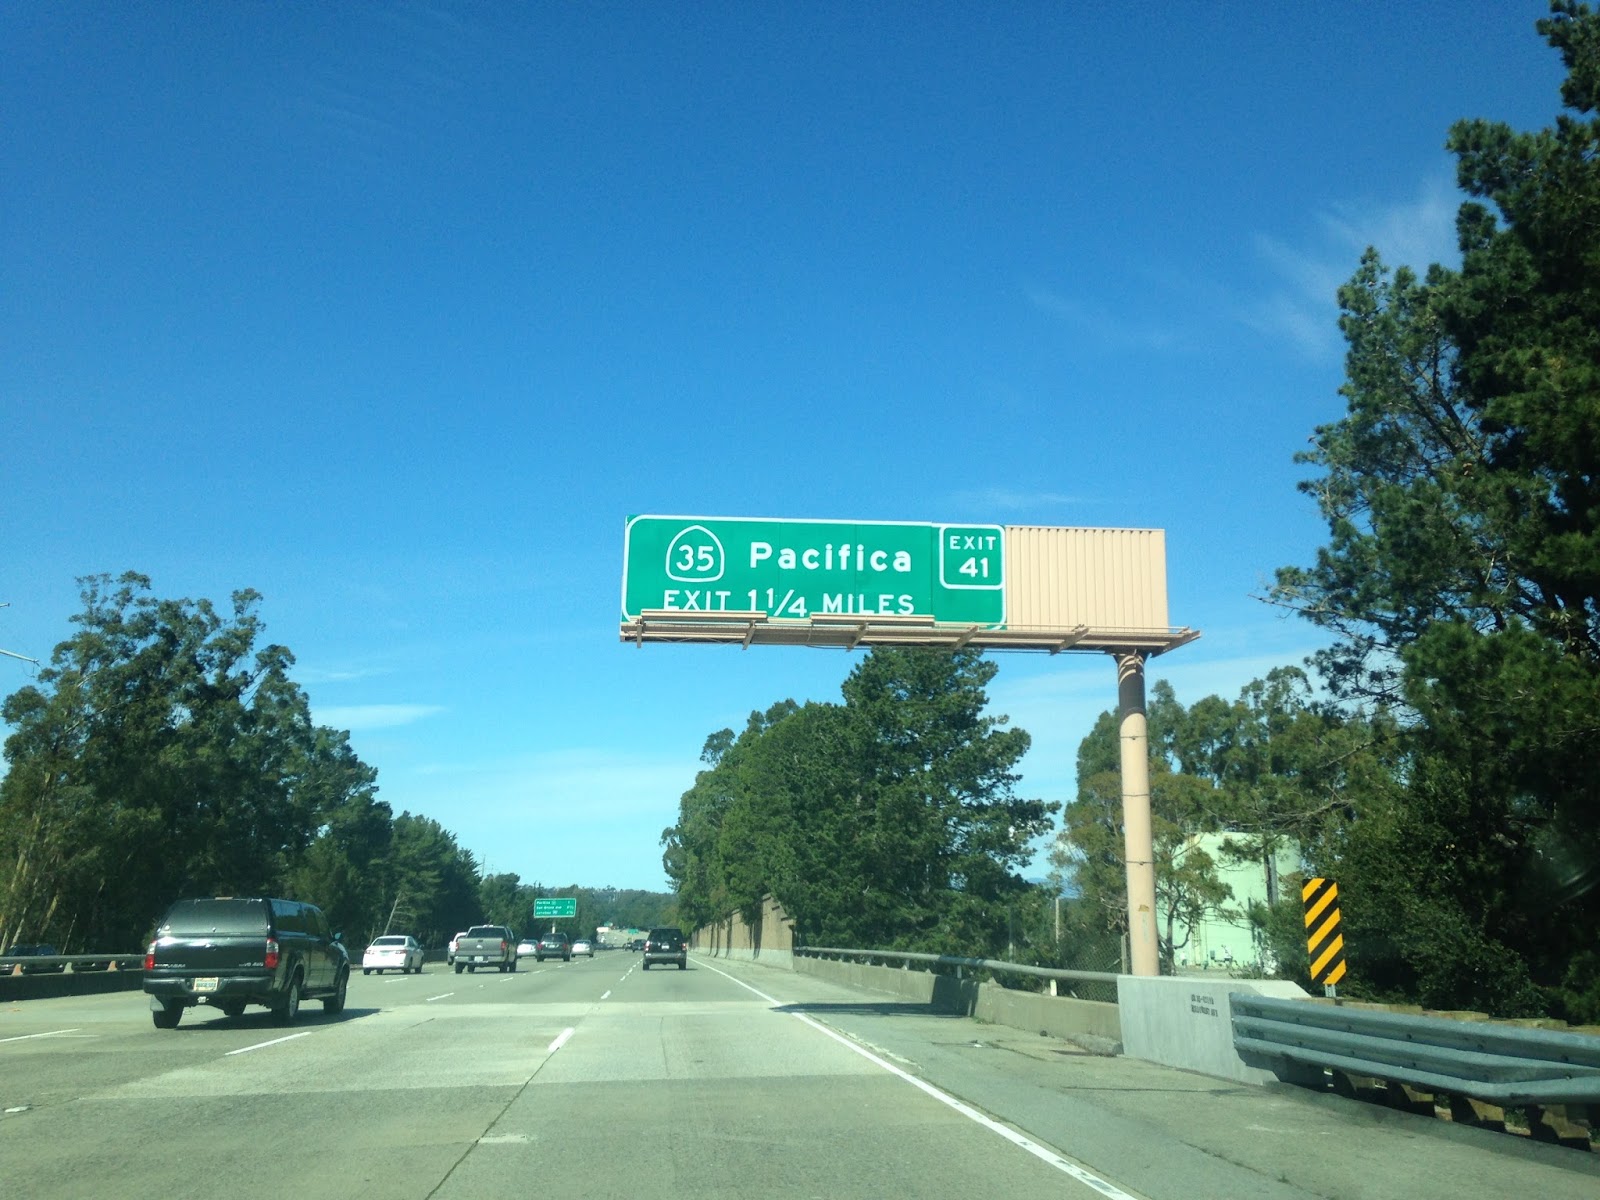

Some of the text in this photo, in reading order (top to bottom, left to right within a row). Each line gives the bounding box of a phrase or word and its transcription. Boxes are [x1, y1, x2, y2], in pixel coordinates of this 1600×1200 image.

[949, 535, 997, 551] EXIT
[676, 544, 715, 572] 35
[749, 541, 912, 573] Pacifica
[958, 556, 989, 578] 41
[663, 589, 731, 611] EXIT
[822, 592, 915, 615] MILES
